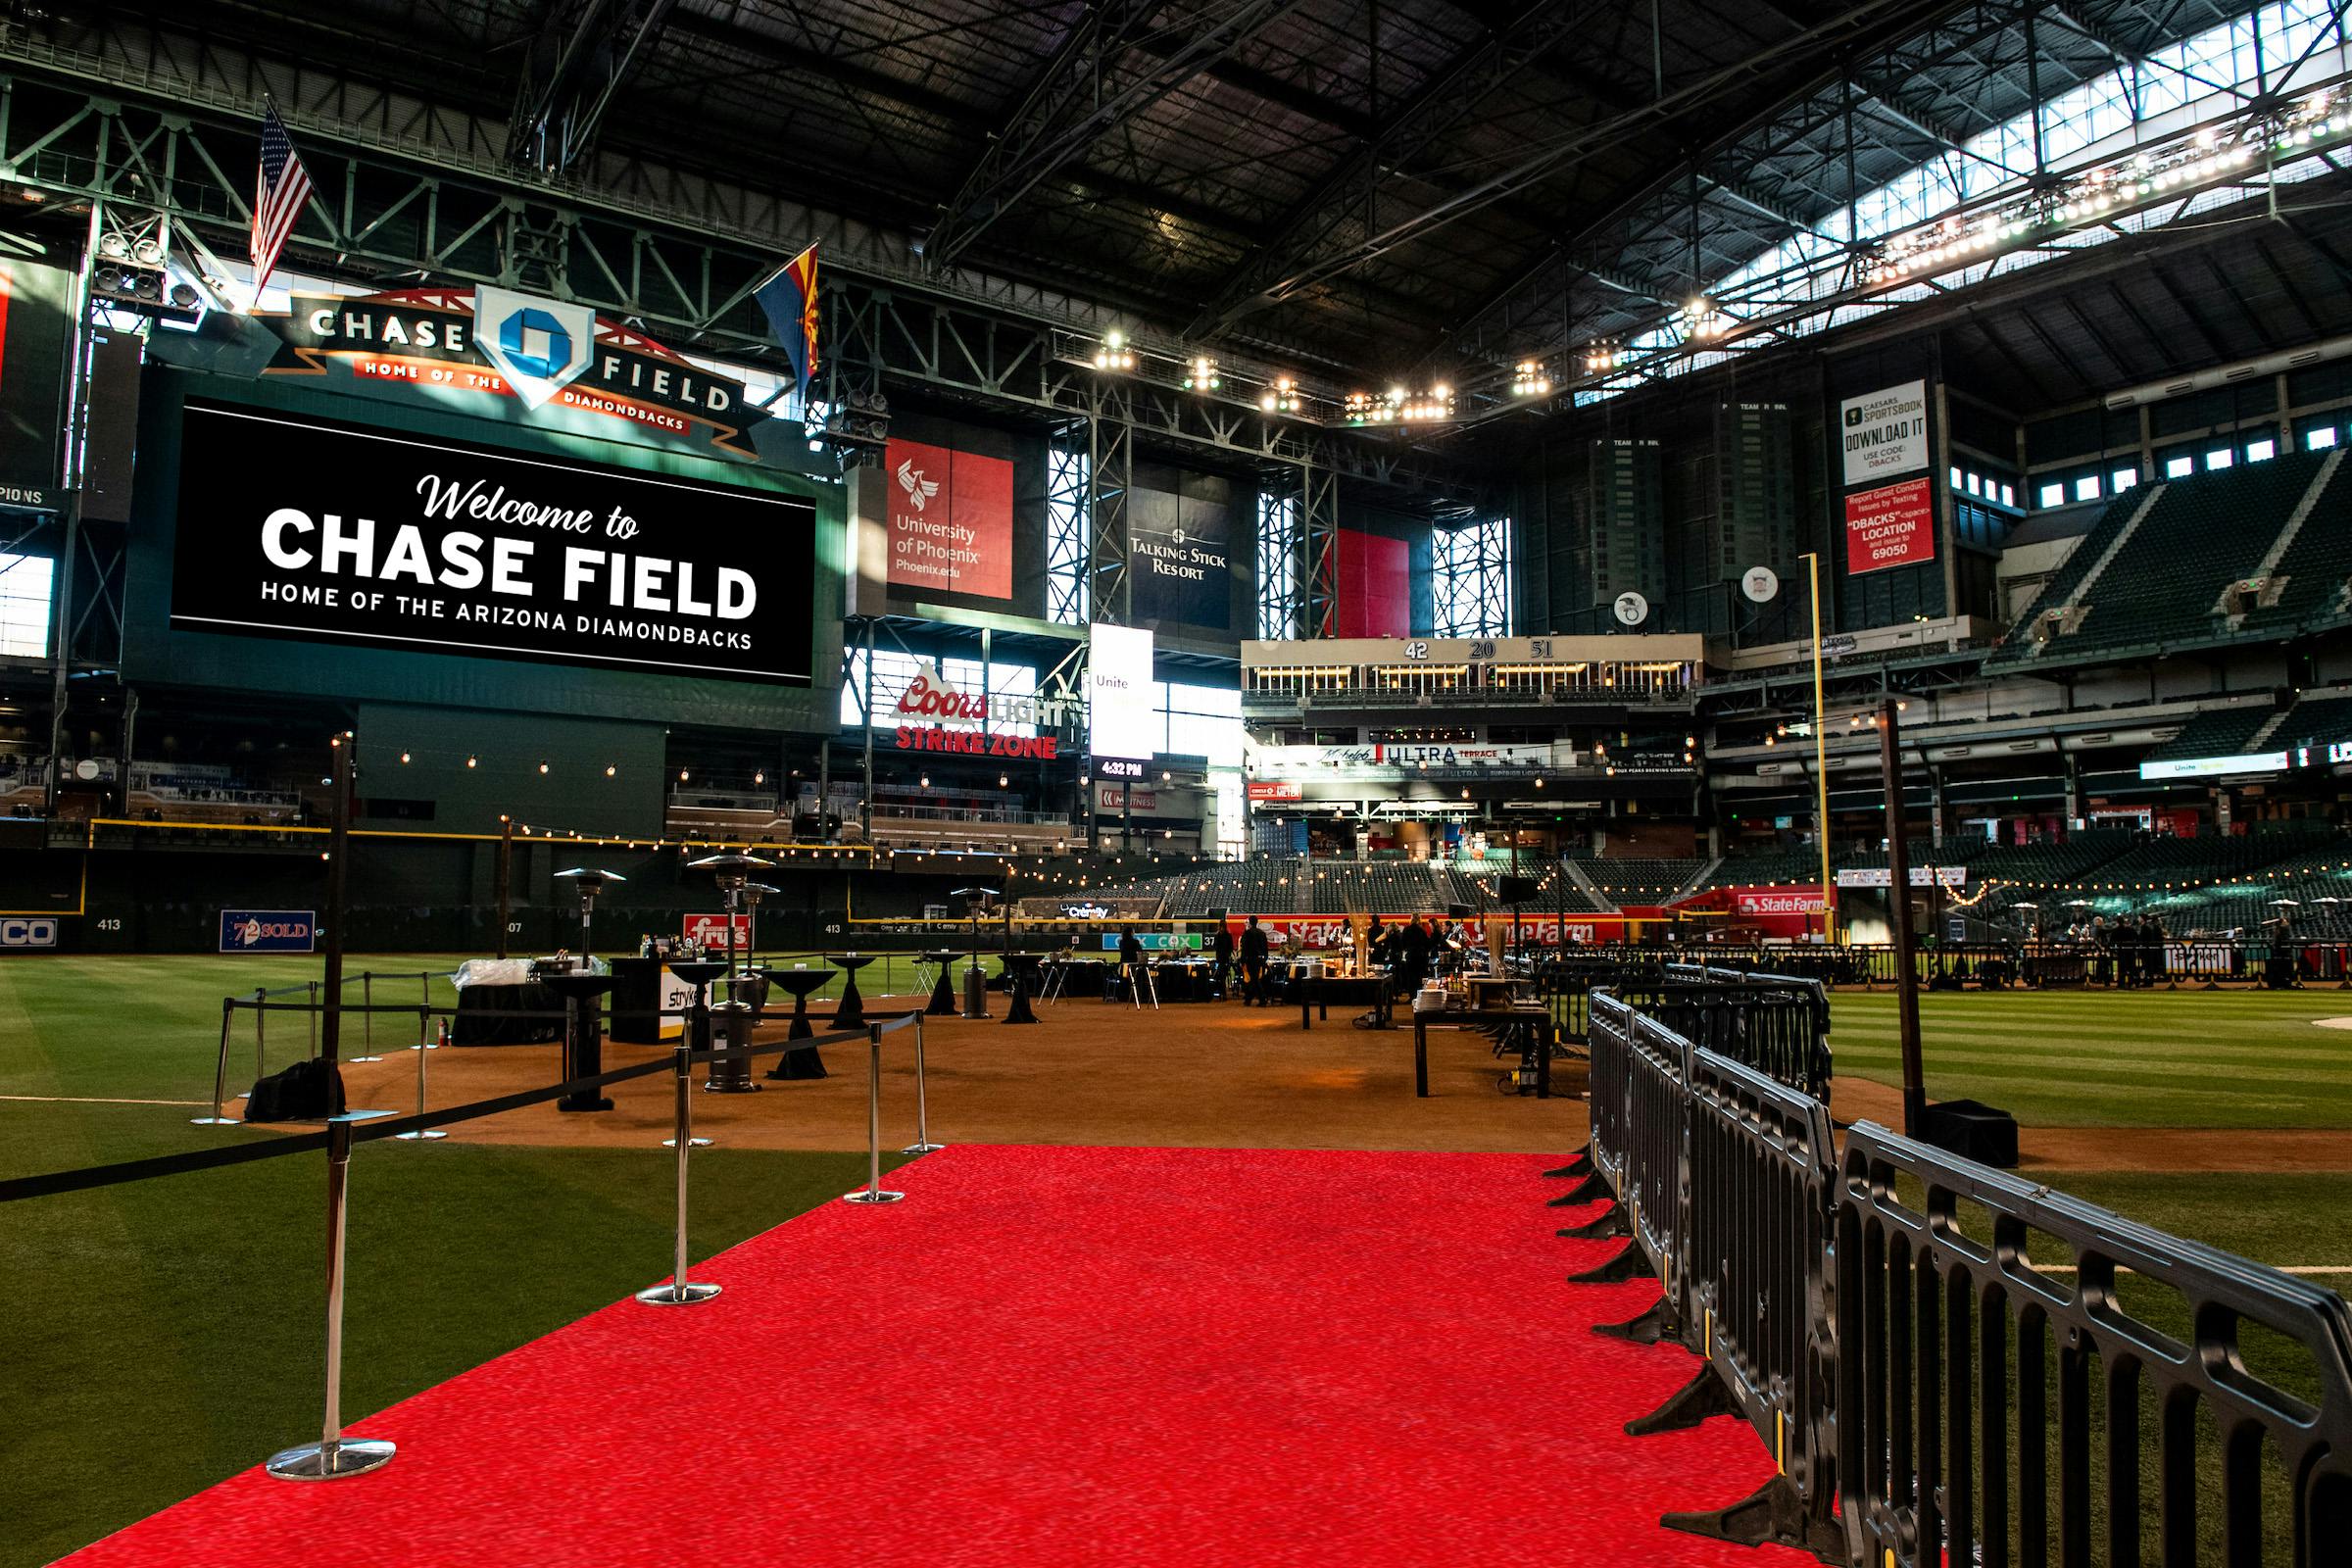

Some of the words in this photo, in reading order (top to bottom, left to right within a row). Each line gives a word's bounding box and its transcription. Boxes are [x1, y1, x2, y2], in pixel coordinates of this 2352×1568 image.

[309, 309, 466, 352] CHASE
[604, 357, 731, 412] FIELD
[365, 361, 418, 379] HOME
[431, 368, 455, 382] OF
[466, 373, 502, 391] THE
[564, 391, 685, 430] DIAMONDBACKS
[1863, 396, 1898, 412] CAESARS
[1864, 399, 1923, 423] SPORTSBOOK
[1845, 420, 1908, 452] DOWNLOAD
[1912, 417, 1924, 436] IT
[1863, 451, 1879, 461] USE
[1880, 444, 1906, 458] CODE:
[1868, 454, 1901, 468] DBACKS
[1848, 493, 1873, 506] Report
[1873, 487, 1894, 500] Guest
[1895, 480, 1927, 494] Conduct
[1857, 501, 1881, 513] Issues
[1881, 499, 1891, 509] by
[1892, 493, 1919, 505] Texting
[416, 474, 592, 534] Welcome
[605, 506, 640, 540] to
[897, 514, 976, 546] University
[1862, 520, 1916, 541] LOCATION
[897, 537, 913, 554] of
[916, 539, 979, 564] Phoenix
[1130, 537, 1187, 562] TALKING
[1190, 547, 1226, 568] STICK
[1869, 539, 1883, 549] and
[1883, 536, 1901, 546] issue
[1872, 543, 1908, 560] 69050
[262, 508, 534, 596] CHASE
[564, 546, 758, 620] FIELD
[896, 559, 960, 578] Phoenix.edu
[1152, 558, 1204, 580] RESORT
[262, 581, 338, 608] HOME
[351, 591, 383, 612] OF
[396, 596, 445, 618] THE
[456, 603, 566, 632] ARIZONA
[576, 615, 753, 651] DIAMONDBACKS
[1405, 641, 1429, 660] 42
[1470, 640, 1496, 659] 20
[1531, 639, 1553, 659] 51
[1097, 674, 1128, 689] Unite
[898, 675, 988, 719] Coors
[989, 697, 1067, 726] LIGHT
[896, 725, 985, 755] STRIKE
[989, 733, 1057, 760] ZONE
[1388, 747, 1456, 761] ULTRA
[1459, 750, 1497, 759] TERRACE
[1102, 761, 1125, 775] 4:32
[1126, 762, 1143, 777] PM
[2175, 763, 2196, 772] Unite
[97, 919, 121, 930] 413
[507, 922, 522, 933] 07
[825, 924, 840, 934] 413
[1114, 936, 1147, 948] CX
[1157, 935, 1191, 948] COX
